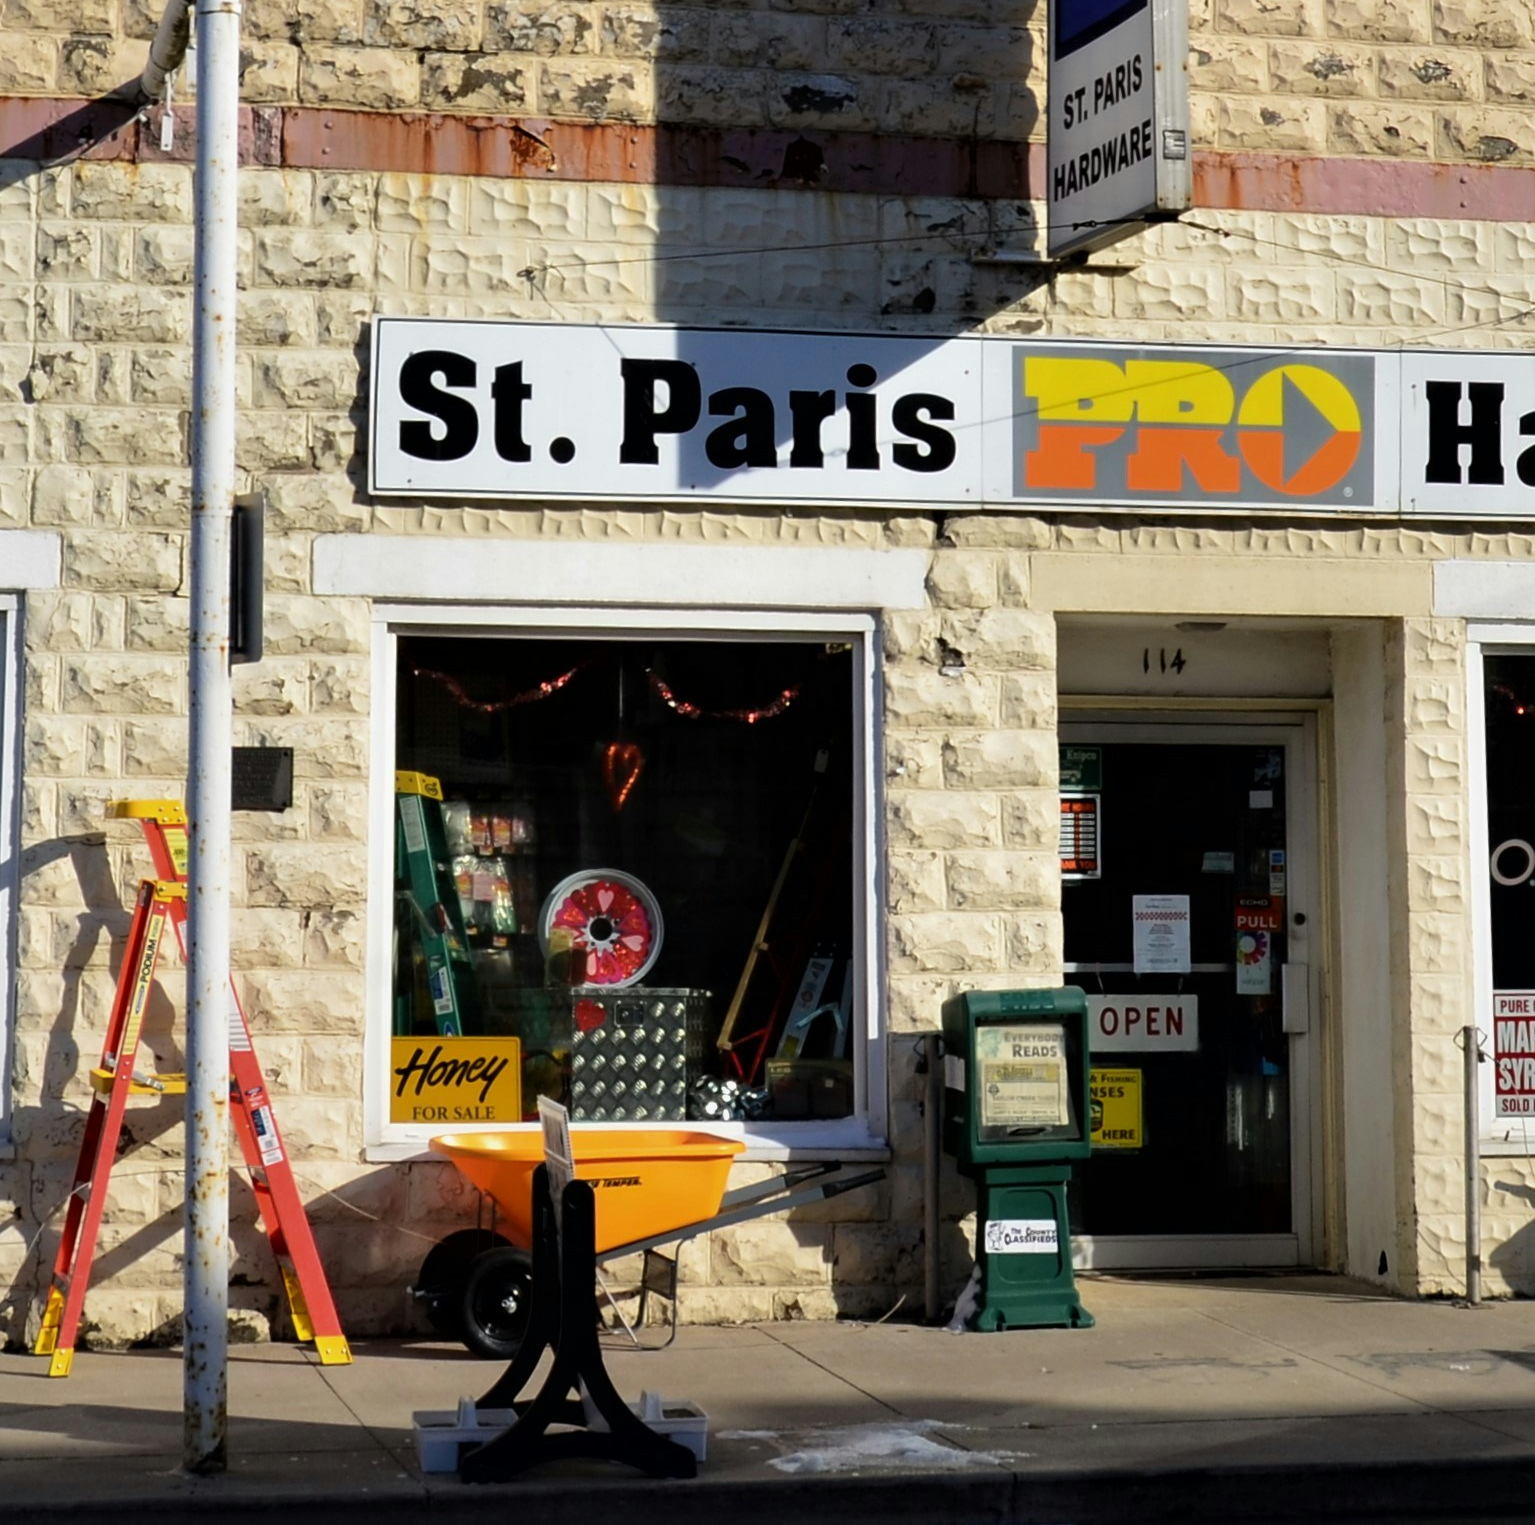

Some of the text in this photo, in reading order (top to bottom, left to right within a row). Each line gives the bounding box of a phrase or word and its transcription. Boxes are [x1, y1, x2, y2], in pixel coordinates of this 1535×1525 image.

[1063, 54, 1143, 130] ST. PARIS
[1053, 118, 1152, 203] HARDWARE
[399, 350, 576, 465] St.
[619, 357, 957, 473] Paris
[1024, 356, 1362, 497] PRO
[1143, 647, 1187, 675] 114
[1239, 898, 1269, 906] ECHO
[1236, 915, 1278, 929] PULL
[140, 939, 157, 983] PODIUM
[1500, 999, 1530, 1013] PURE
[1099, 1006, 1184, 1036] OPEN
[1012, 1044, 1058, 1057] READS
[394, 1045, 509, 1103] Honey
[1101, 1074, 1137, 1084] FISHING
[412, 1105, 496, 1121] FOR SALE
[1501, 1098, 1530, 1112] SOLD
[1102, 1129, 1136, 1140] HERE
